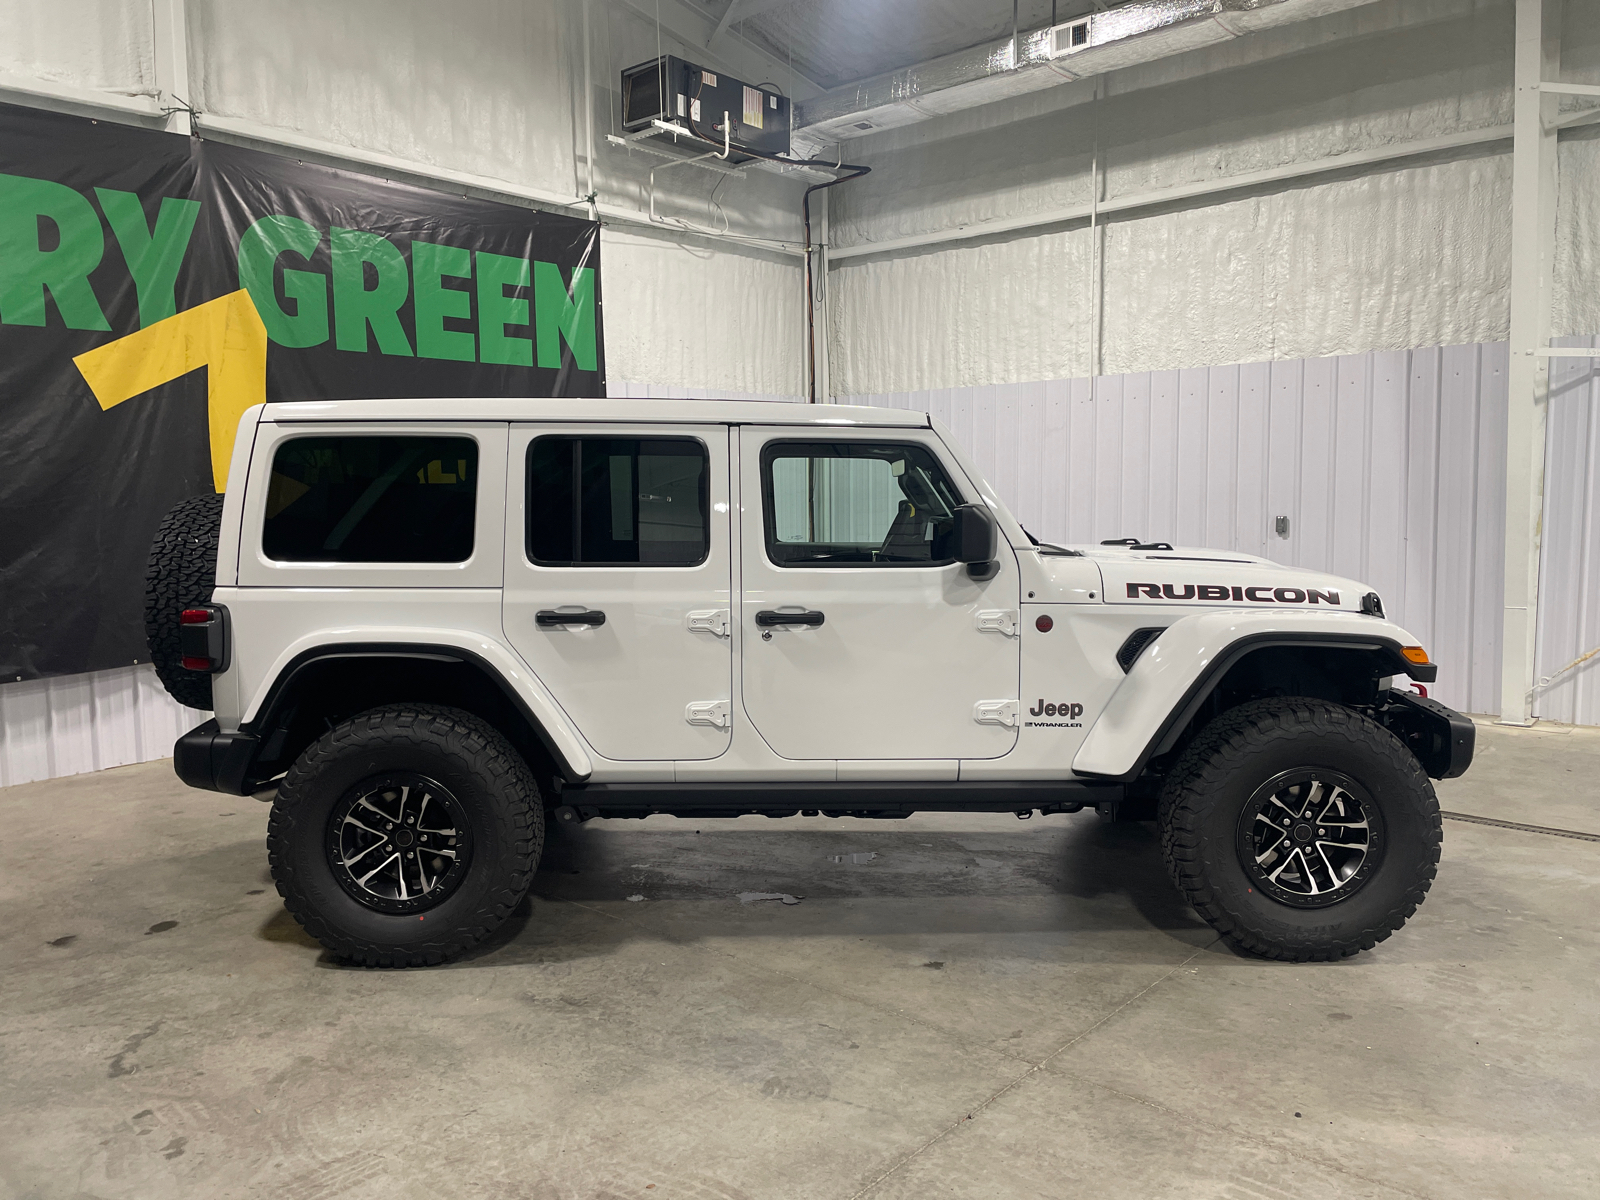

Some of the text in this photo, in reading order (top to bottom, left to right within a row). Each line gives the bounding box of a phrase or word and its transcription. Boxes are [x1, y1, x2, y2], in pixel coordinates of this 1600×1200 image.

[238, 215, 598, 372] GREEN
[1126, 582, 1341, 606] RUBICON
[1029, 698, 1084, 720] Jeep
